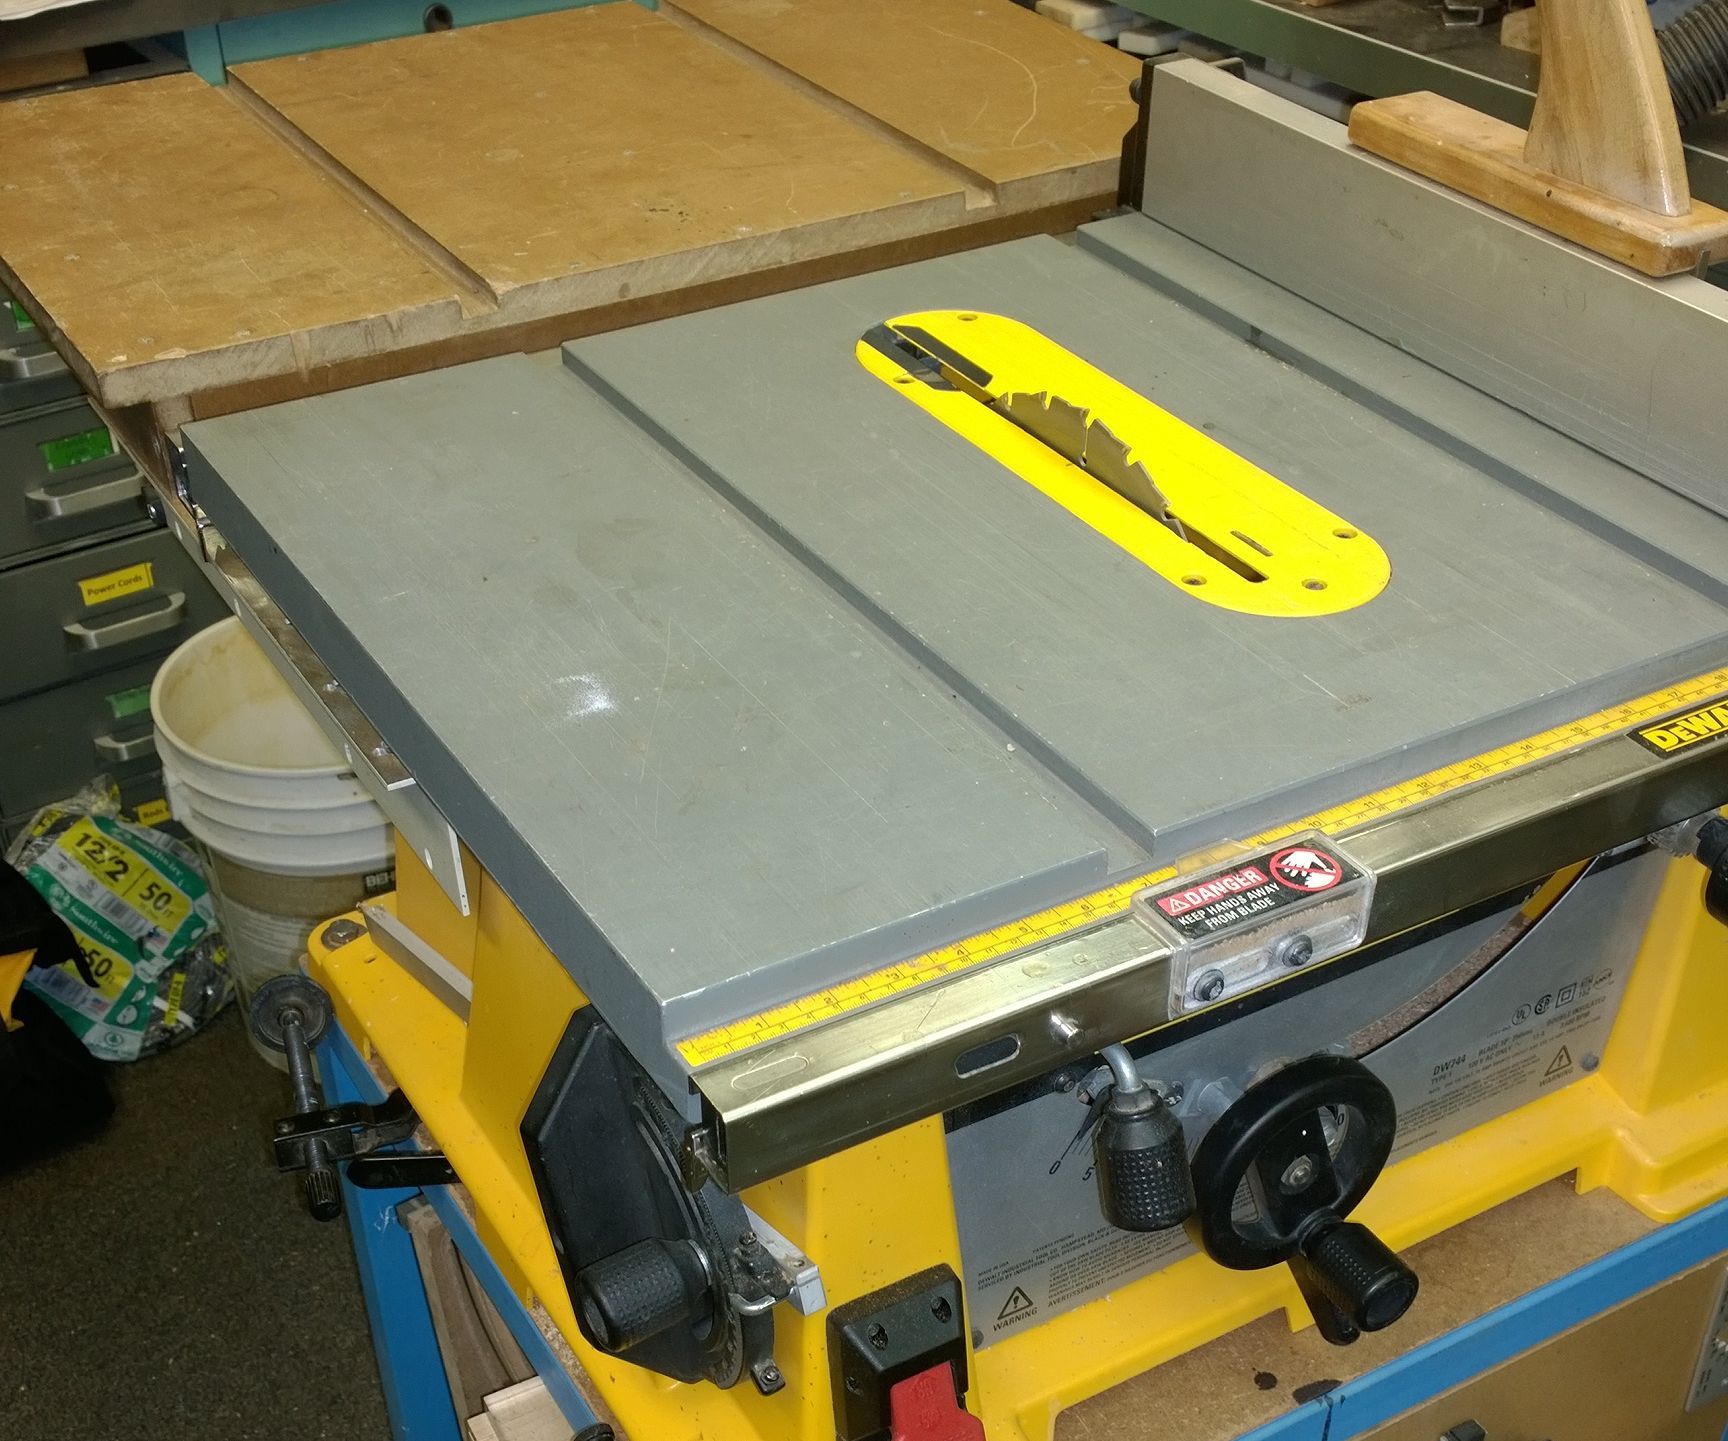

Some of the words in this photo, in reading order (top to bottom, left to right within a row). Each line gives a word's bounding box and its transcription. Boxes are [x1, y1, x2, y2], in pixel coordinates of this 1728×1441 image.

[87, 583, 116, 596] Power
[118, 574, 143, 587] Cords
[74, 832, 129, 883] 12/2
[139, 882, 172, 911] 50
[1185, 868, 1264, 905] DANGER
[1177, 908, 1206, 927] KEEP
[1208, 894, 1248, 915] HANDS
[1248, 882, 1280, 902] AWAY
[1205, 912, 1240, 929] FROM
[1240, 897, 1275, 917] BLADE
[1432, 1054, 1467, 1076] DW744
[1049, 1160, 1061, 1175] 0
[1082, 1165, 1094, 1181] 5
[993, 1307, 1038, 1331] WARNING
